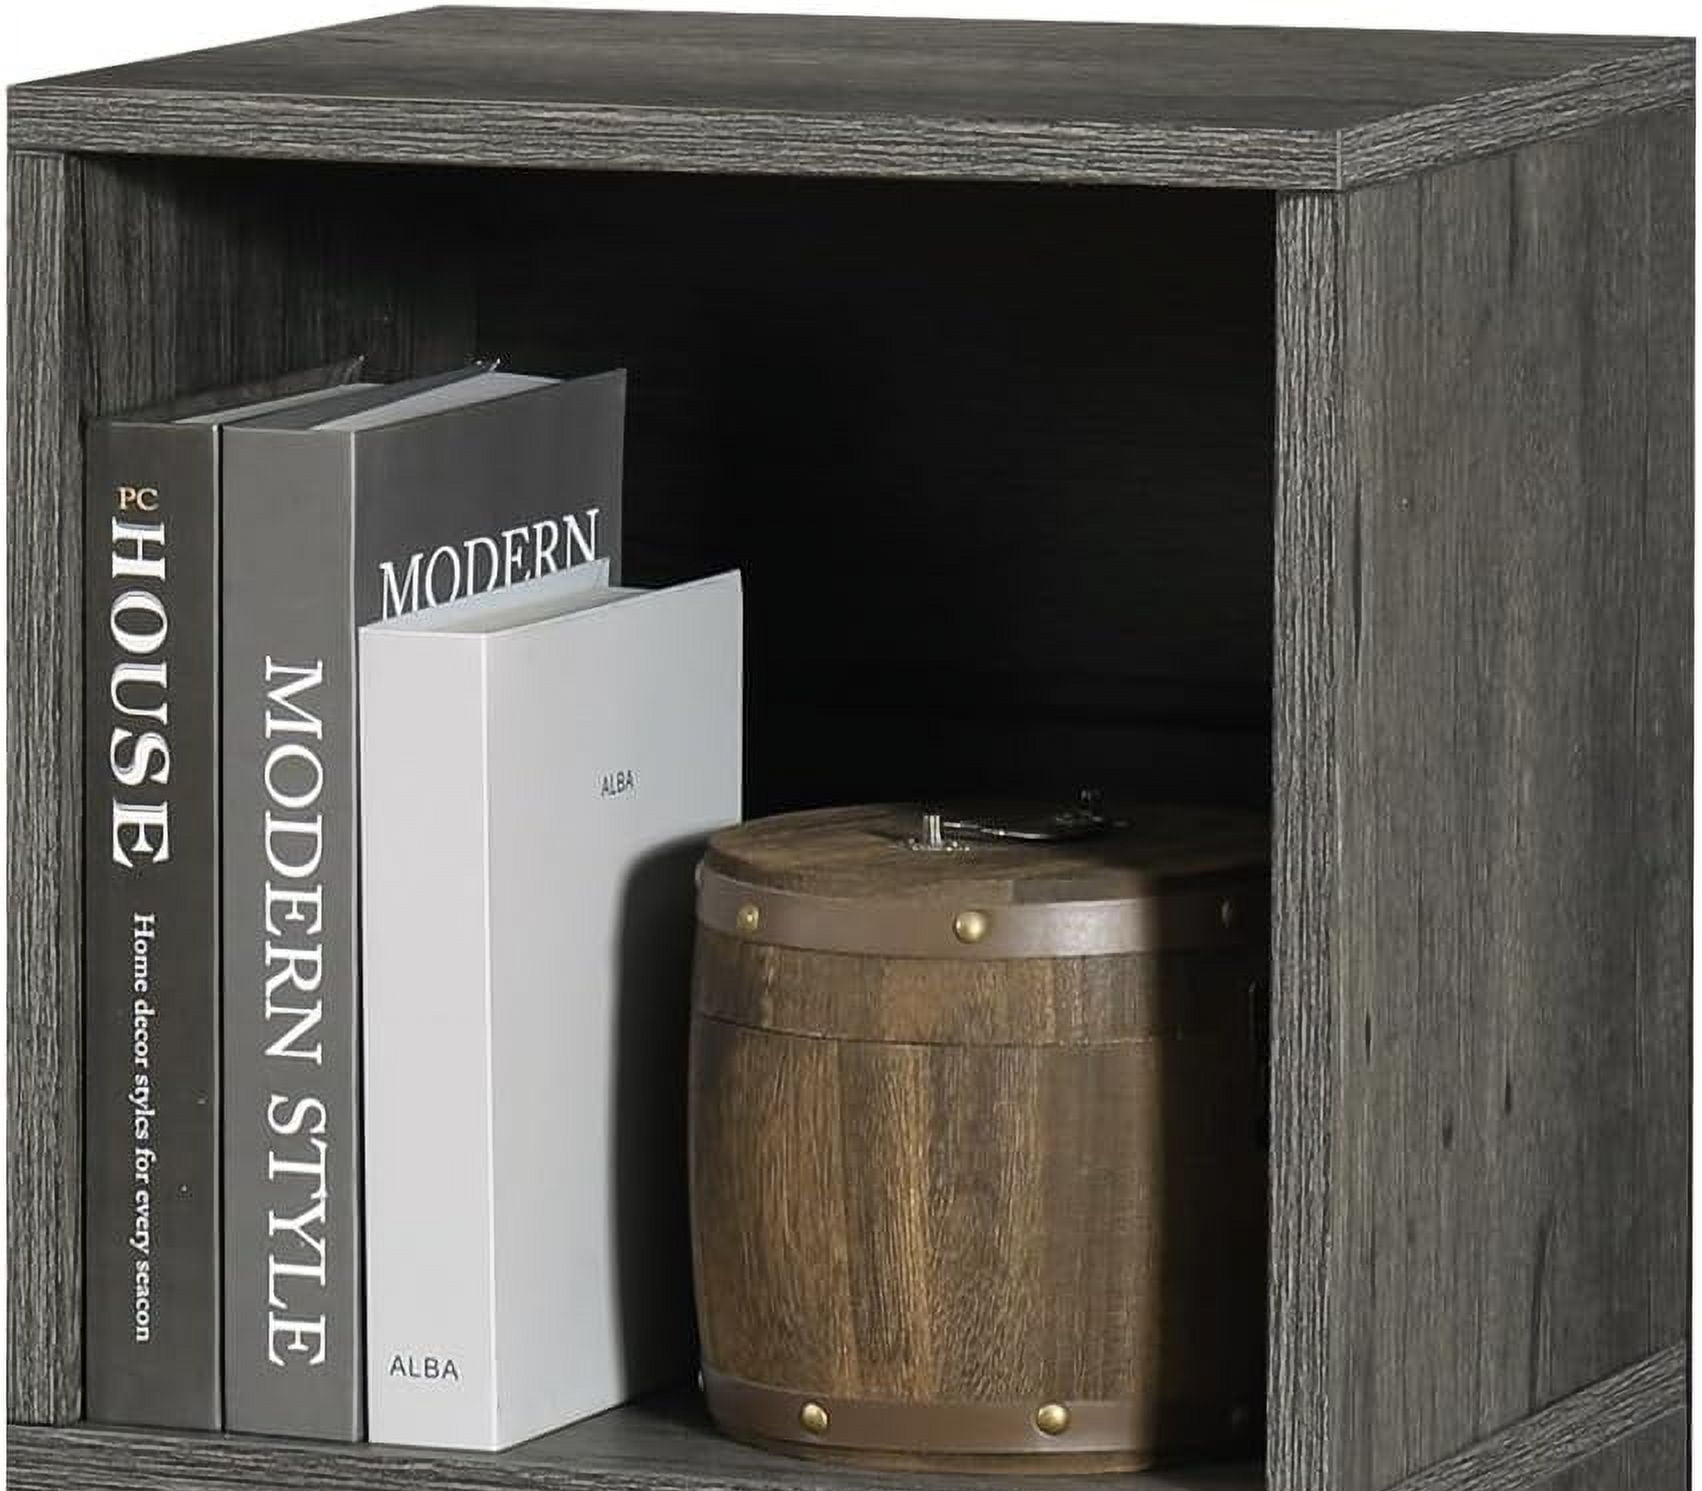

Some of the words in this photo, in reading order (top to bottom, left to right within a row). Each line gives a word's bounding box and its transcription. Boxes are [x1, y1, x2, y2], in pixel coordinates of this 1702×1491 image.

[117, 486, 159, 512] PC
[379, 508, 600, 621] MODERN
[110, 515, 170, 869] HOUSE
[600, 769, 636, 799] ALBA
[263, 654, 325, 1065] MODERN
[132, 912, 157, 993] Home
[132, 998, 157, 1068] decor
[128, 1074, 157, 1140] styles
[133, 1147, 158, 1184] for
[128, 1190, 151, 1254] every
[265, 1093, 329, 1367] STYLE
[388, 1353, 460, 1382] ALBA
